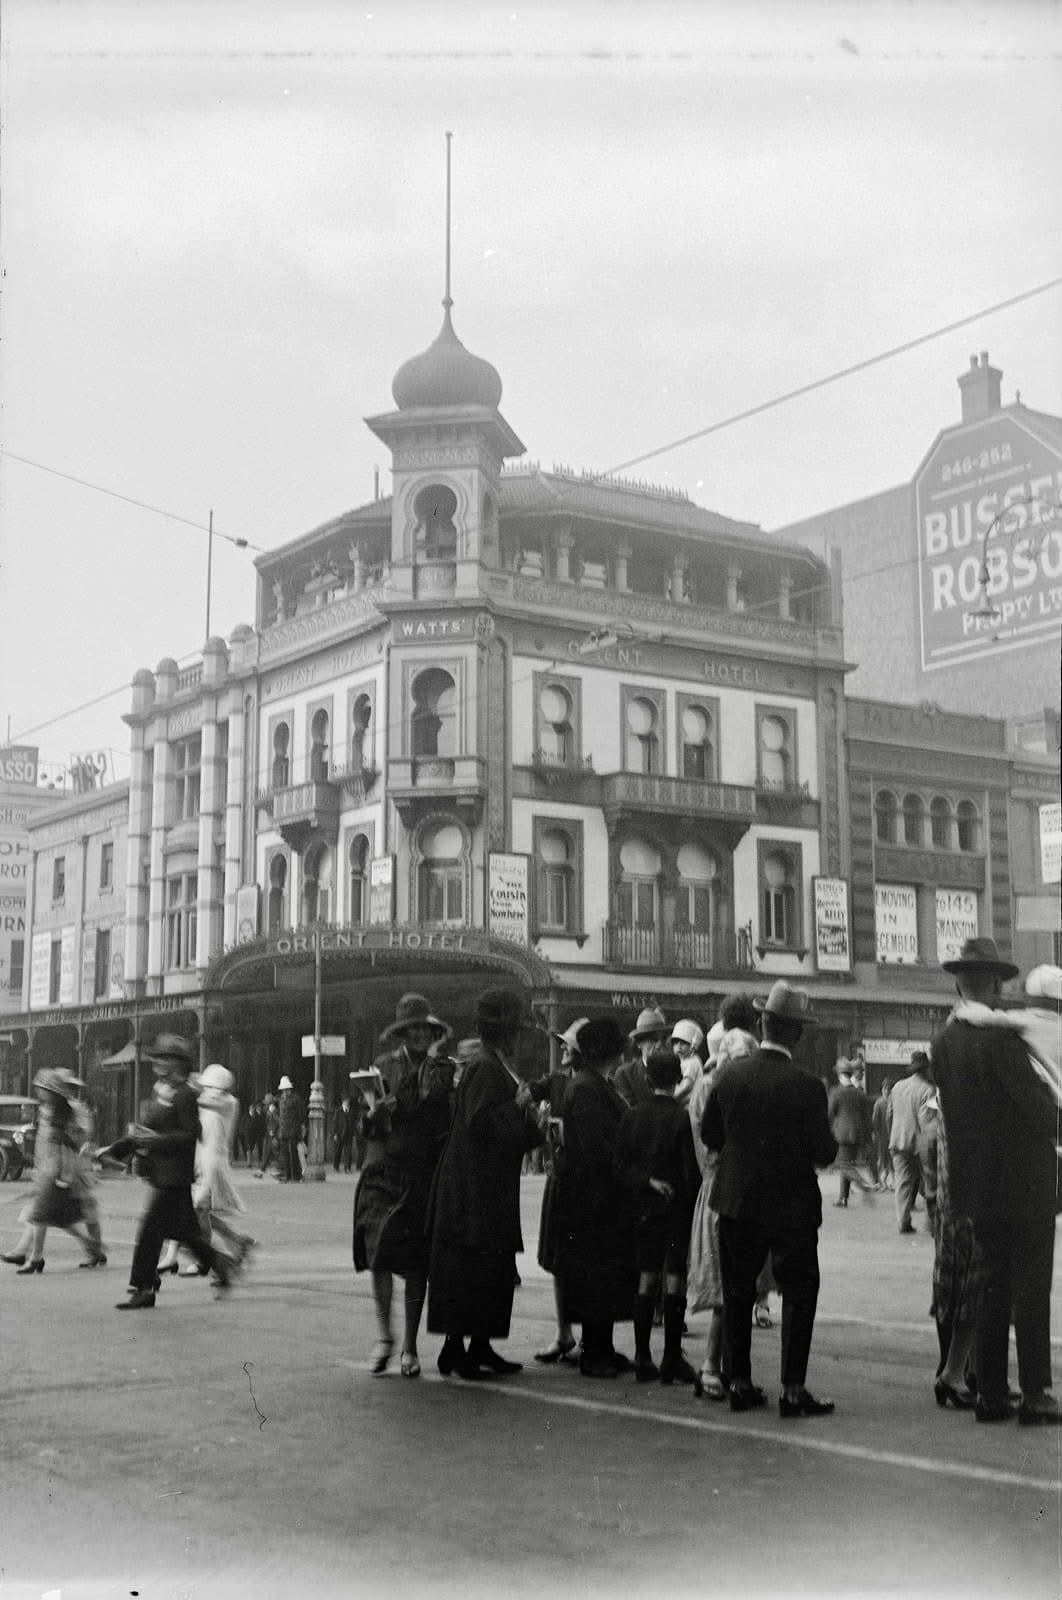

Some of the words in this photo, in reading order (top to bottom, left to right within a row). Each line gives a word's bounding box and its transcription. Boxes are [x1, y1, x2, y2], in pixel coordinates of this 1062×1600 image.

[703, 661, 761, 683] HOTEL
[876, 889, 915, 909] EMOVING
[948, 895, 974, 914] 145
[883, 913, 898, 926] IN
[277, 933, 366, 954] ORIENT
[389, 931, 474, 955] HOTEL
